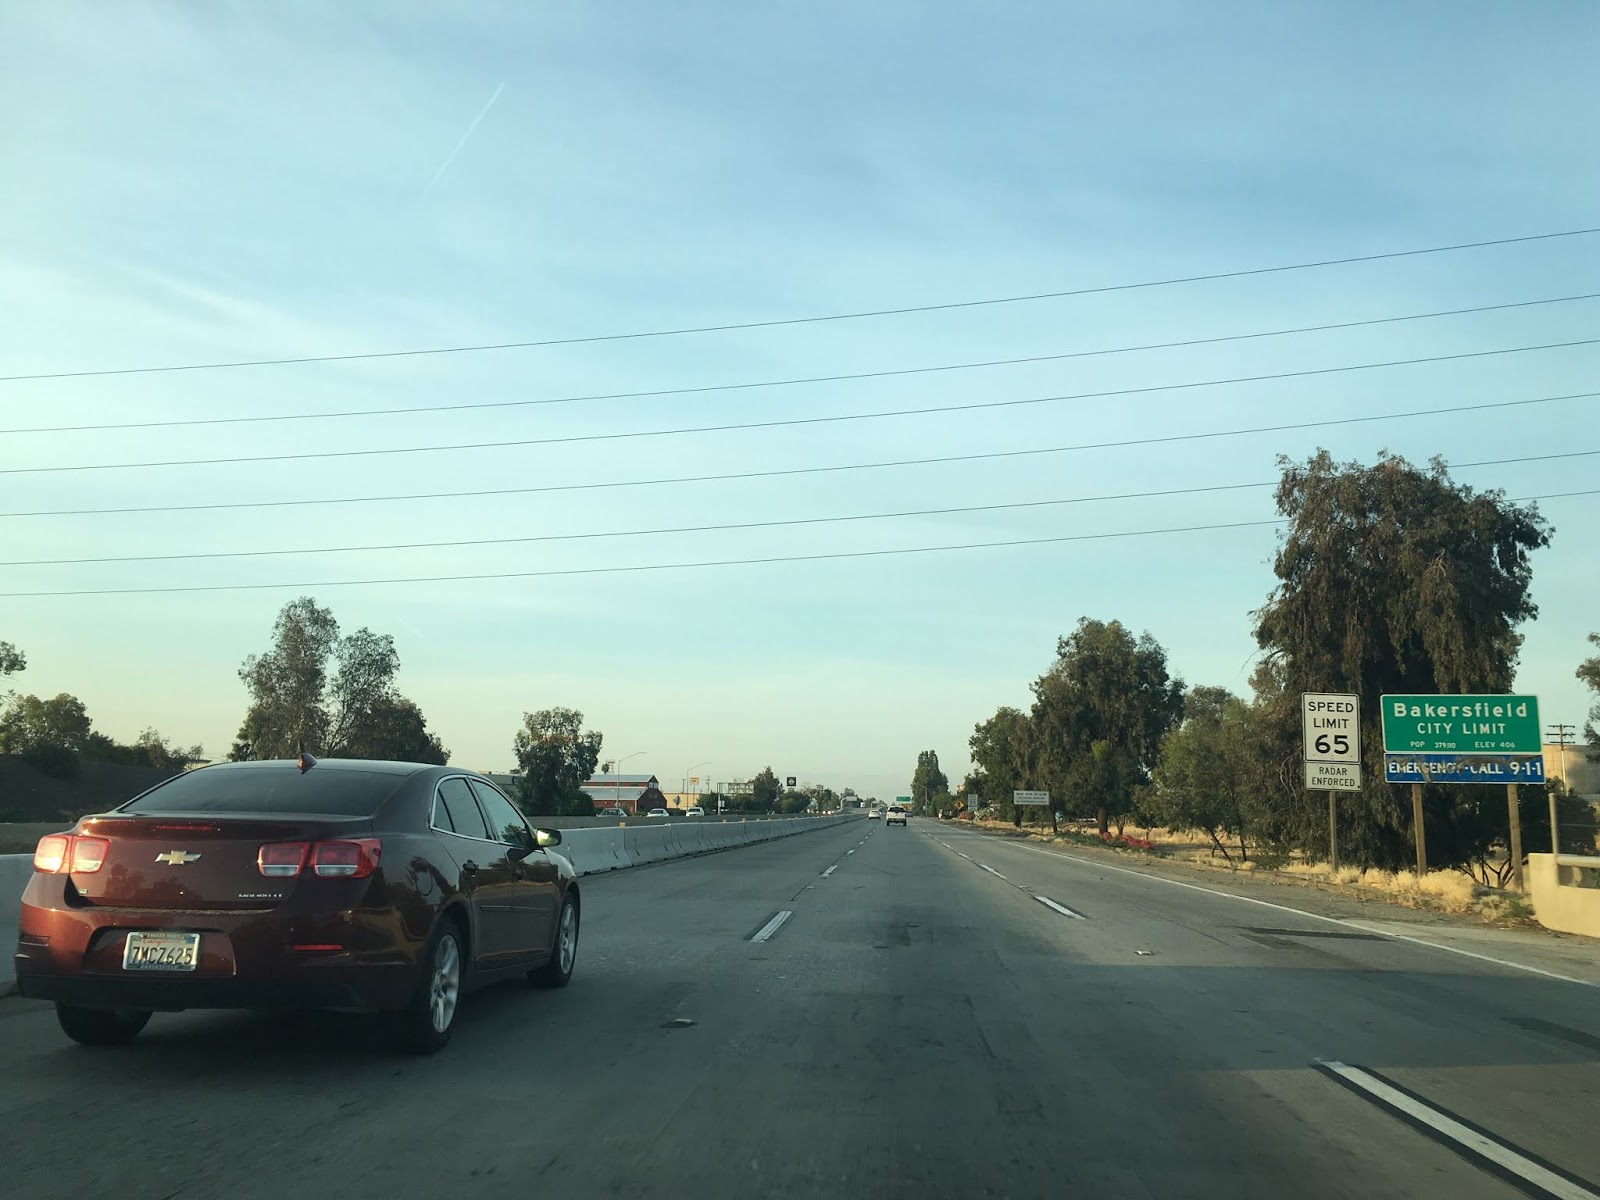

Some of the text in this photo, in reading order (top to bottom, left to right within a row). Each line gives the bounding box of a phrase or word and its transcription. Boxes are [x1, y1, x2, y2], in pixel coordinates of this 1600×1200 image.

[1307, 701, 1354, 713] SPEED
[1393, 702, 1528, 717] Bakersfield
[1313, 717, 1350, 729] LIMIT
[1417, 722, 1506, 735] CITY LIMIT
[1314, 733, 1350, 755] 65
[1410, 740, 1425, 748] POP
[1474, 741, 1496, 749] ELEV
[1499, 741, 1516, 749] 406
[1318, 766, 1348, 776] RADAR
[1470, 762, 1504, 774] CALL
[1509, 761, 1542, 776] 9-1-1
[1311, 776, 1356, 787] ENFORCED
